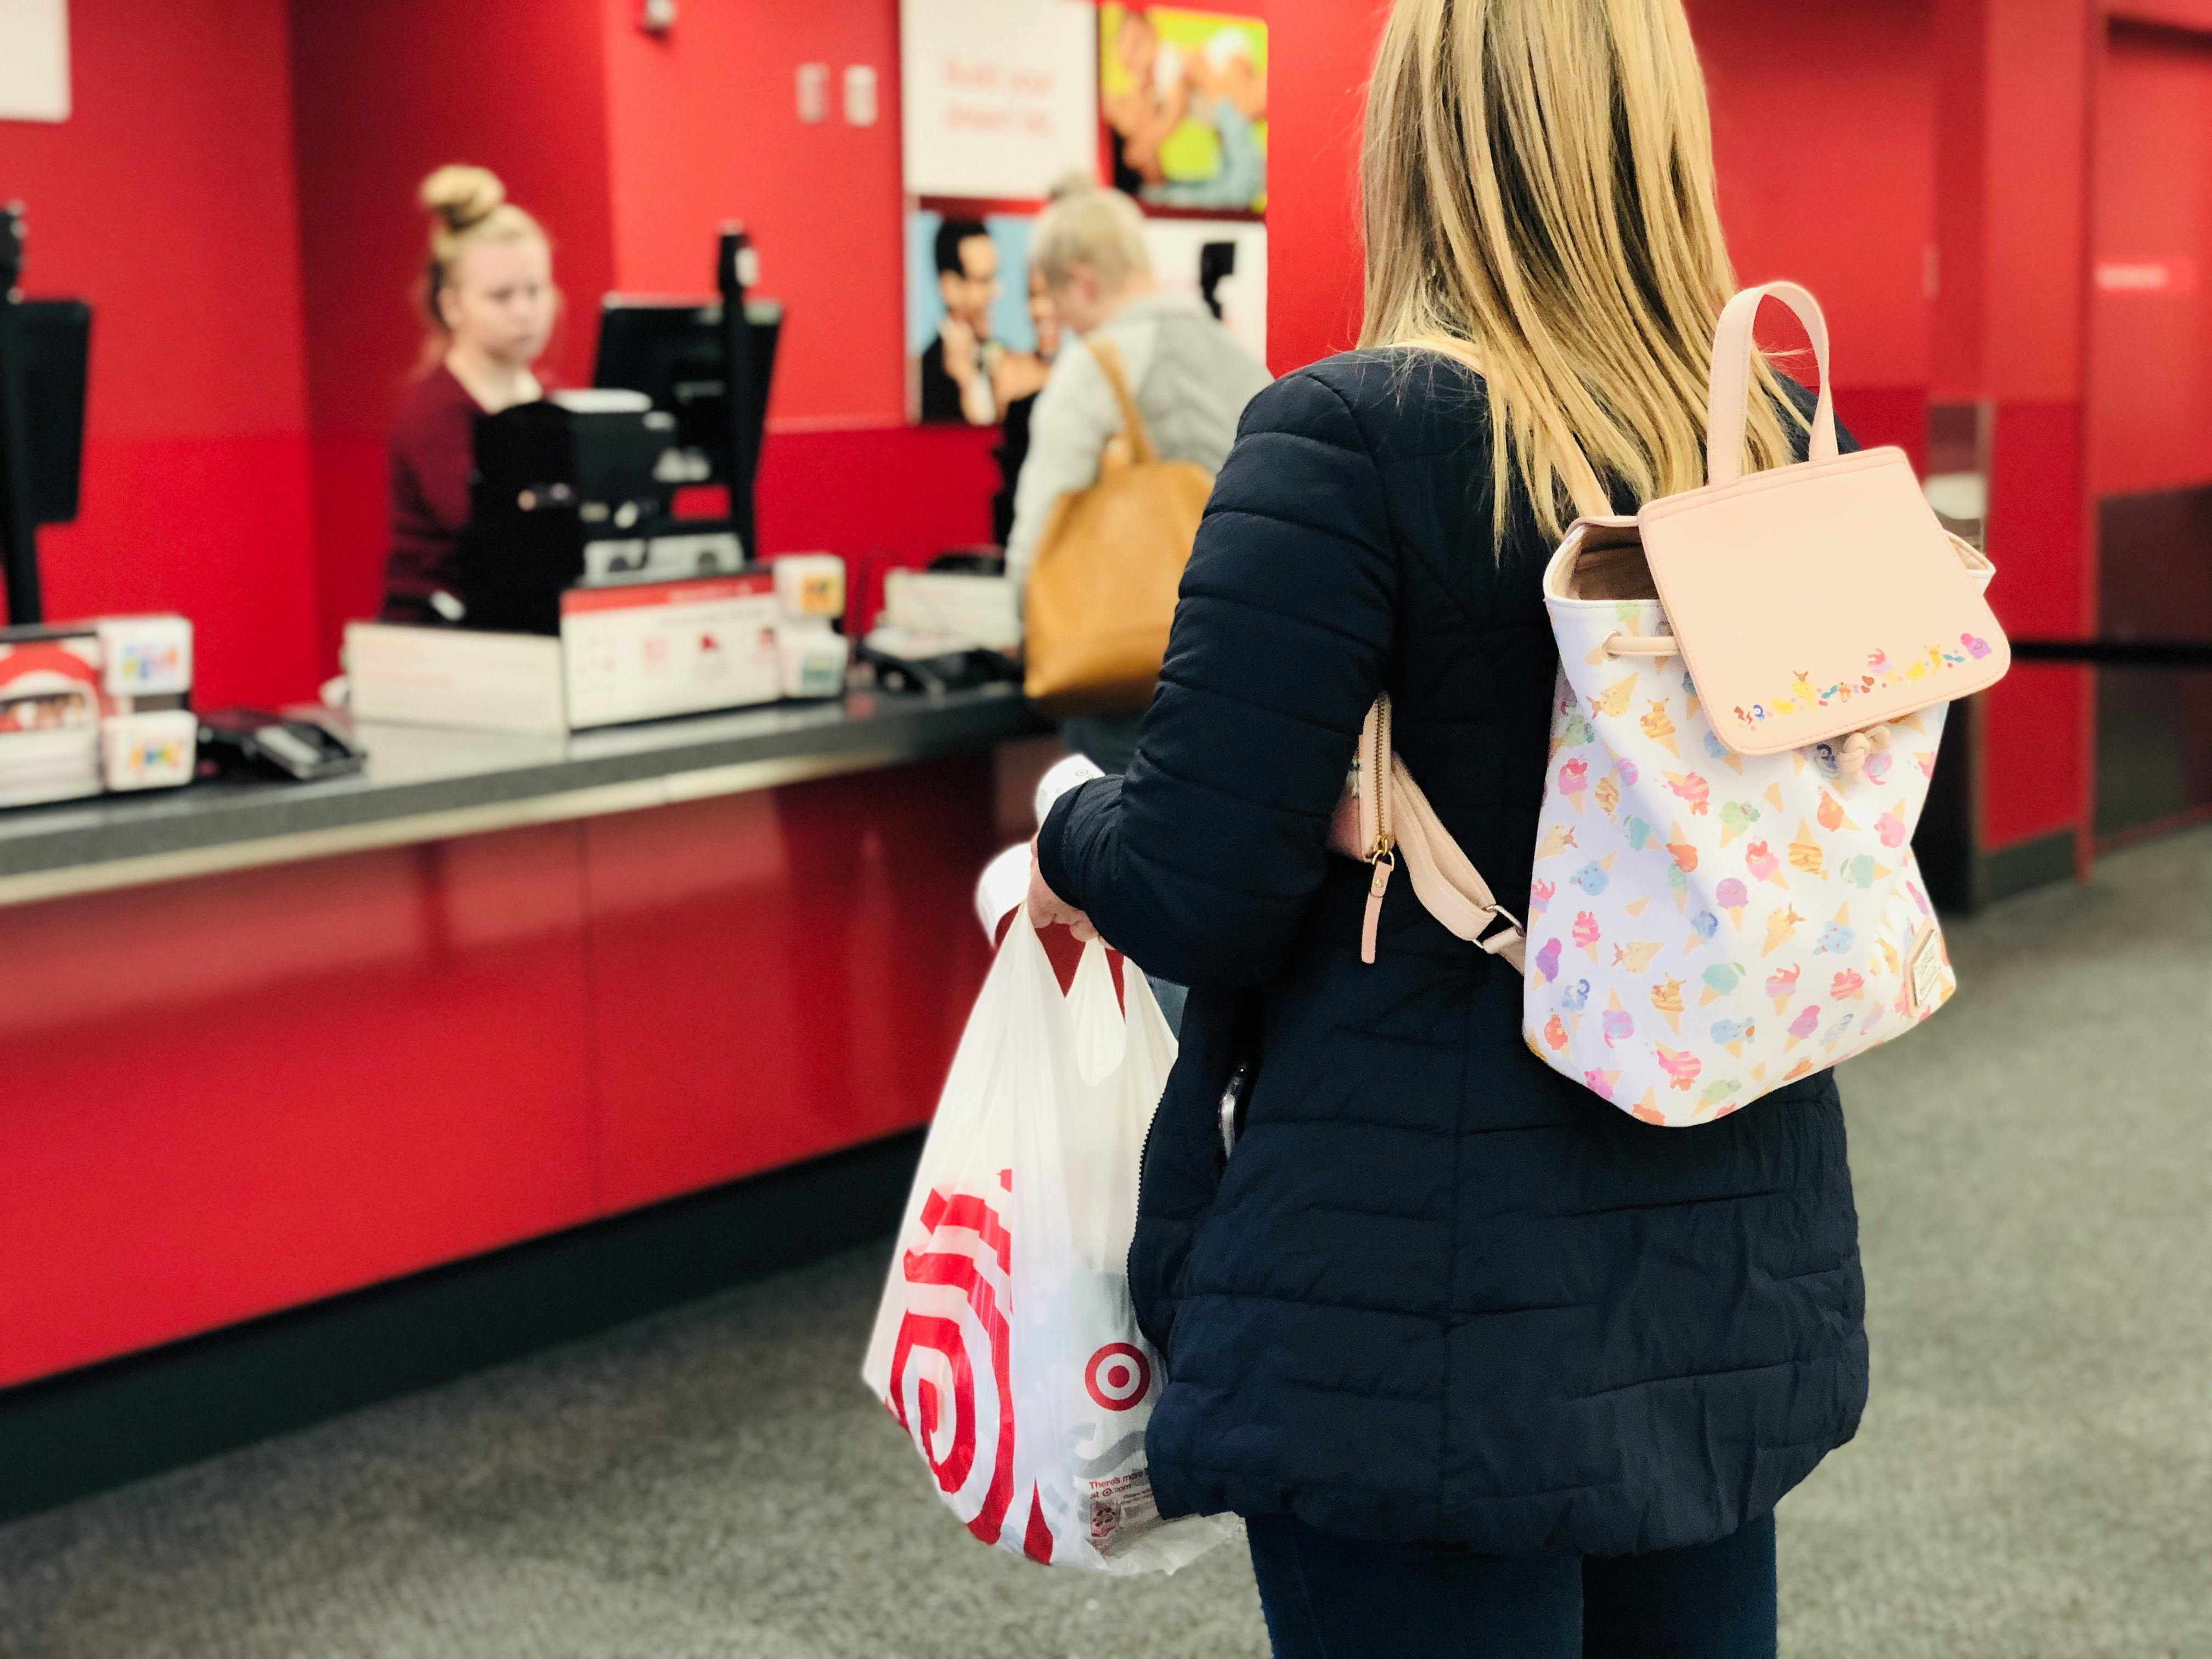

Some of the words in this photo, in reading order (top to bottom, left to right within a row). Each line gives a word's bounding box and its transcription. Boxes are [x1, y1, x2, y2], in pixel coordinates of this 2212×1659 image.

[1089, 1476, 1120, 1489] There's
[1122, 1471, 1144, 1482] more
[1091, 1491, 1099, 1500] at
